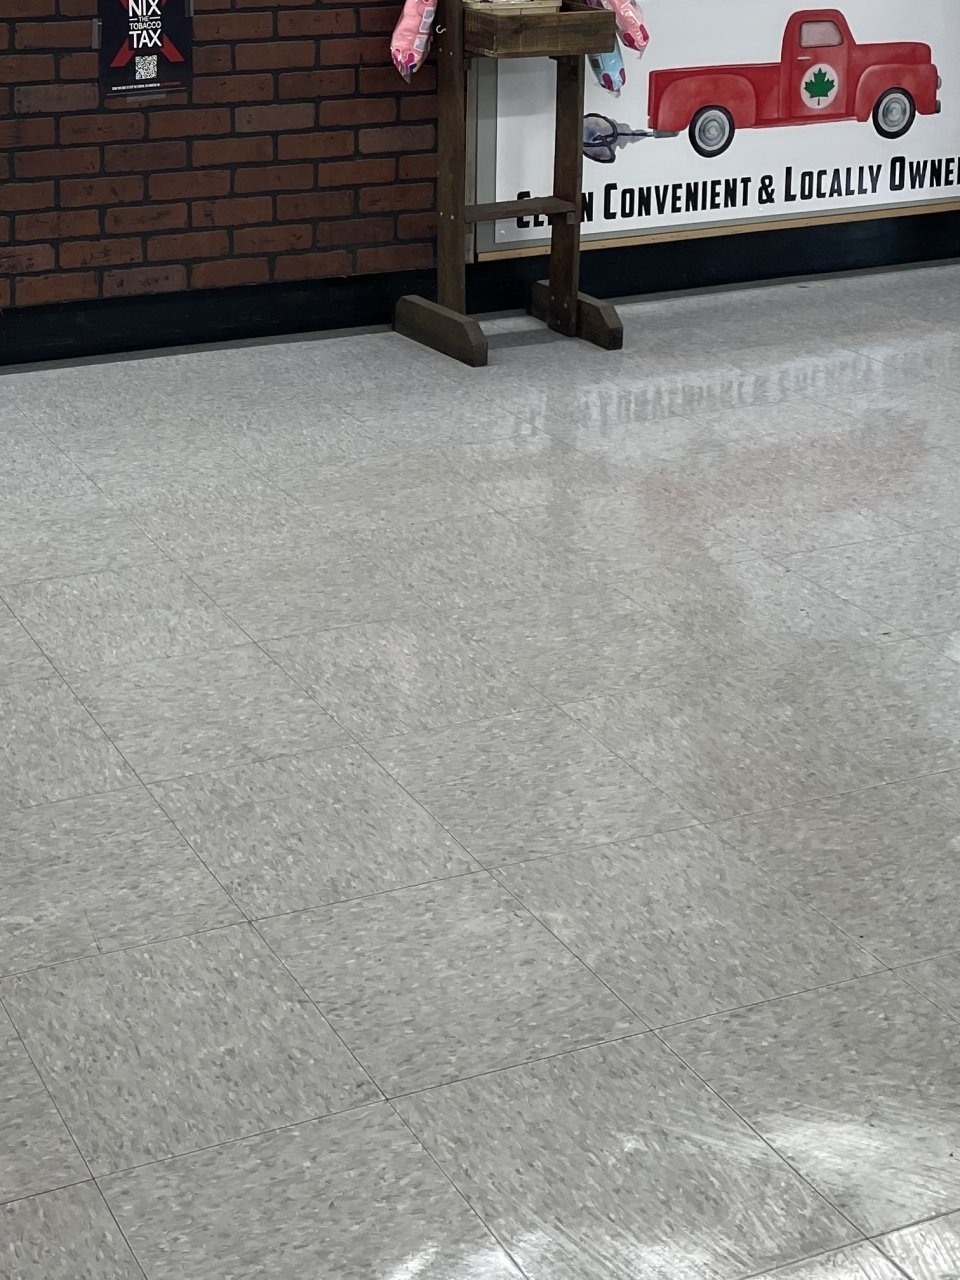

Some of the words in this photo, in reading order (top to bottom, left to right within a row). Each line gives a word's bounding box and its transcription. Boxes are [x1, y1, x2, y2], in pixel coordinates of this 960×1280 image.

[129, 20, 162, 30] TOBACCO
[128, 28, 162, 49] TAX
[603, 175, 752, 220] CONVENIENT
[757, 173, 776, 205] &
[783, 164, 883, 202] LOCALLY
